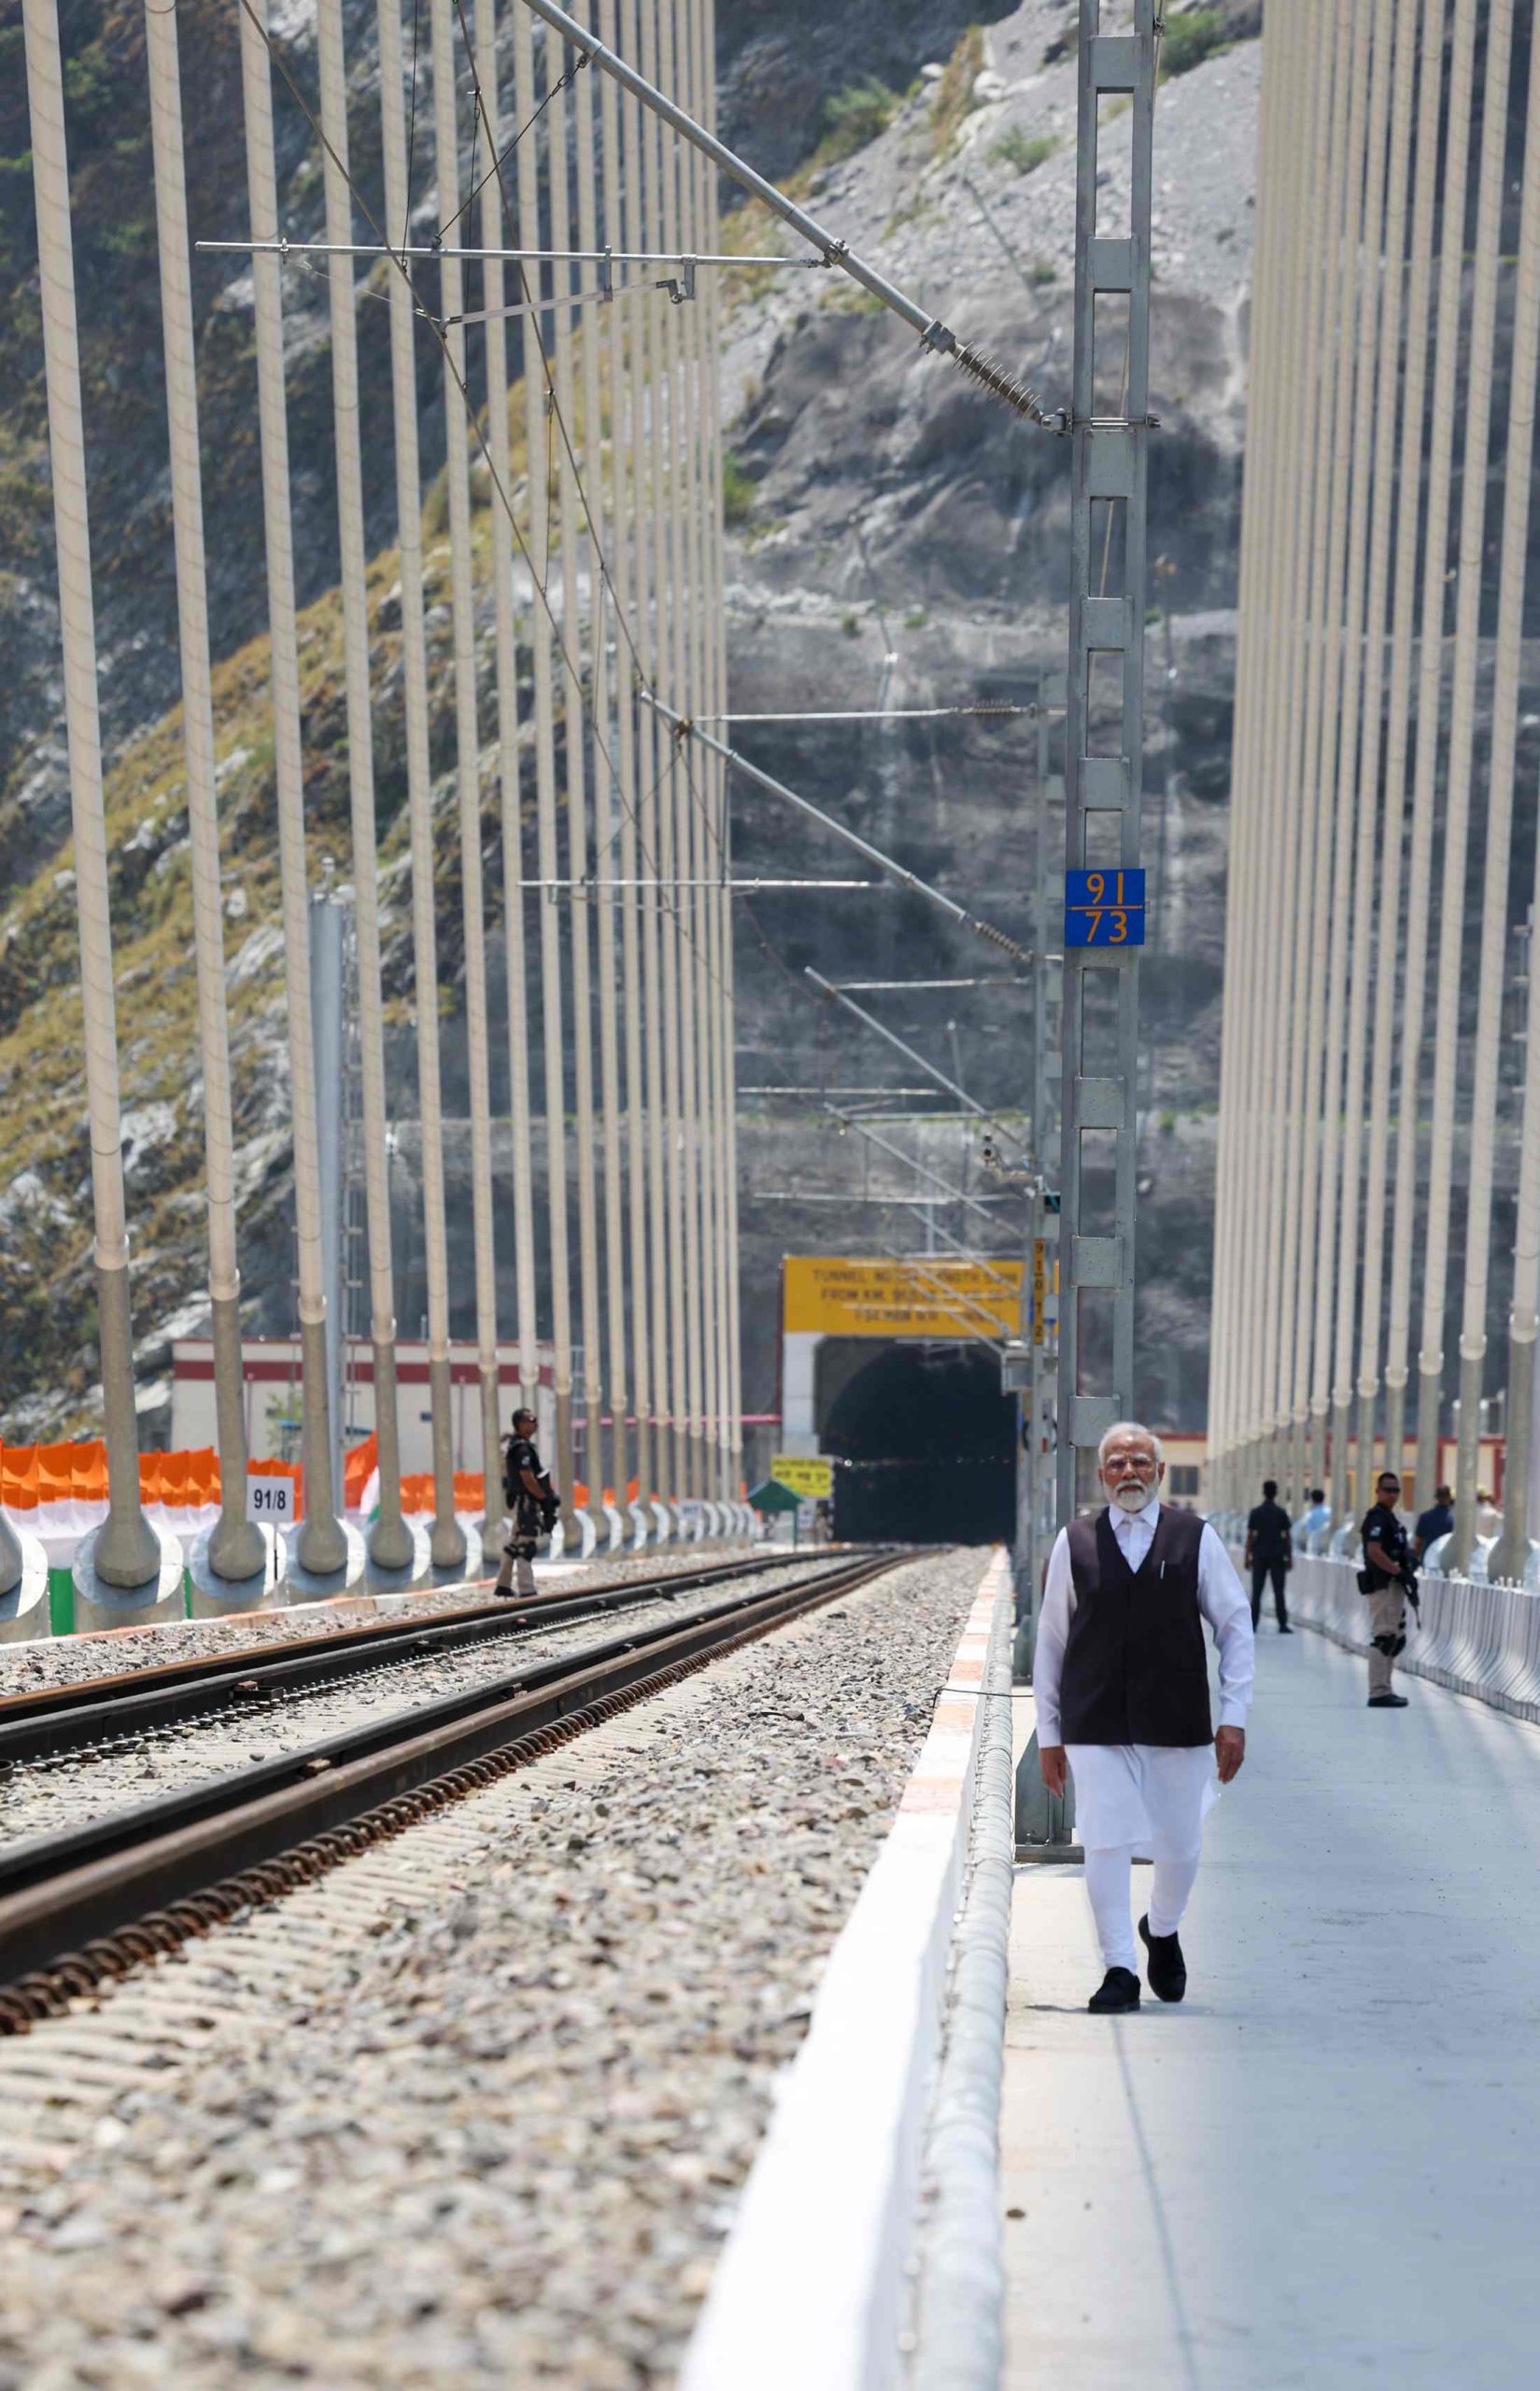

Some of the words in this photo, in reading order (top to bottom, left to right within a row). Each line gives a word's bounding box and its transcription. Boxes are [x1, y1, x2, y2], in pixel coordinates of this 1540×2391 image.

[1086, 871, 1124, 905] 91
[1085, 911, 1127, 942] 73
[254, 1489, 286, 1510] 91/8
